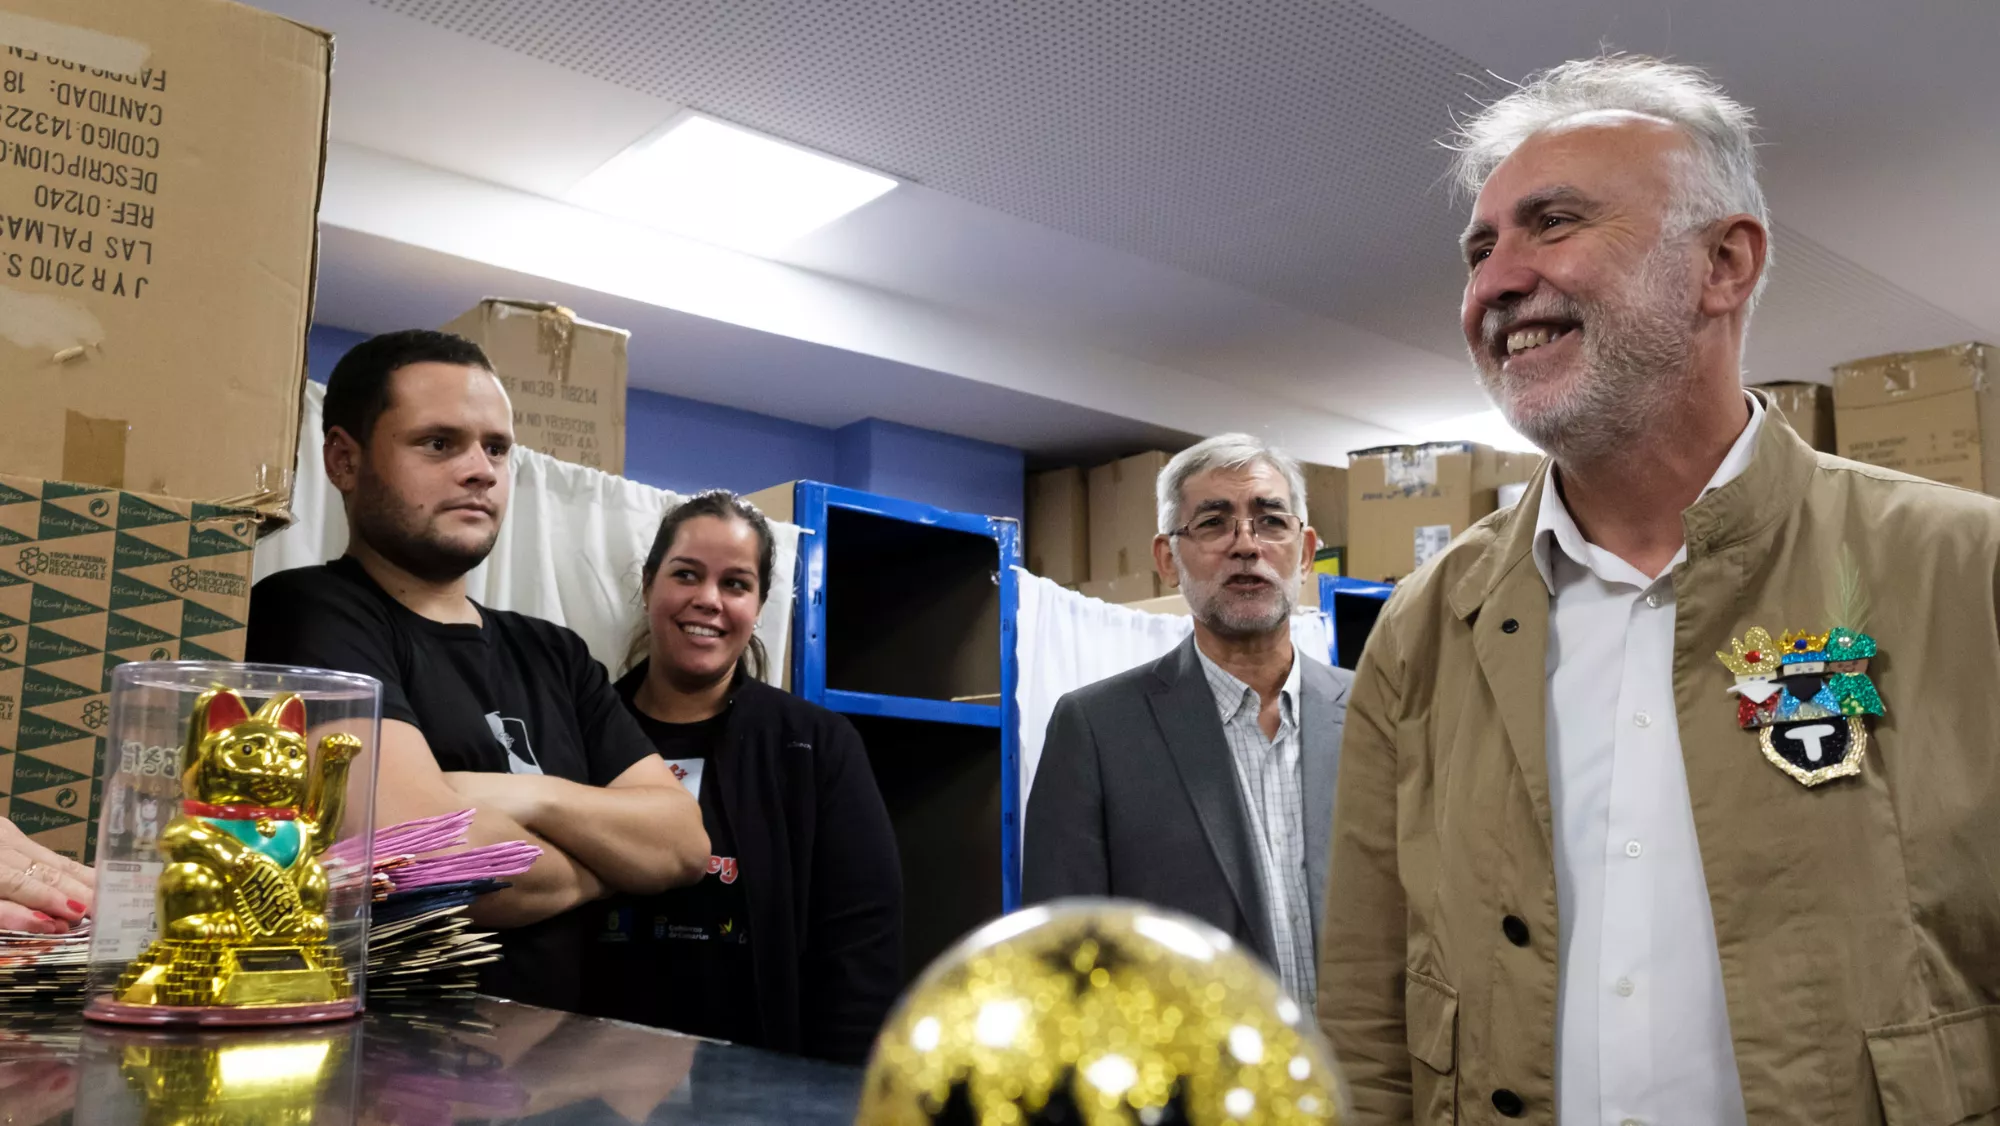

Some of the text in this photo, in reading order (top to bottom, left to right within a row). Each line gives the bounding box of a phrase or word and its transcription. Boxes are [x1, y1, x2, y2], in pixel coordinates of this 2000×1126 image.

[3, 69, 25, 94] 18
[50, 80, 163, 126] CANTIDAD:
[0, 104, 72, 141] 14322
[34, 185, 100, 218] 01240
[105, 236, 152, 265] LAS
[30, 256, 86, 287] 2010
[92, 267, 106, 292] R
[112, 272, 125, 297] Y
[134, 277, 149, 299] J
[49, 552, 106, 563] 100% MATERIAL
[49, 558, 98, 571] RECICLADO
[49, 567, 106, 580] RECICLABLE
[1784, 723, 1836, 762] T
